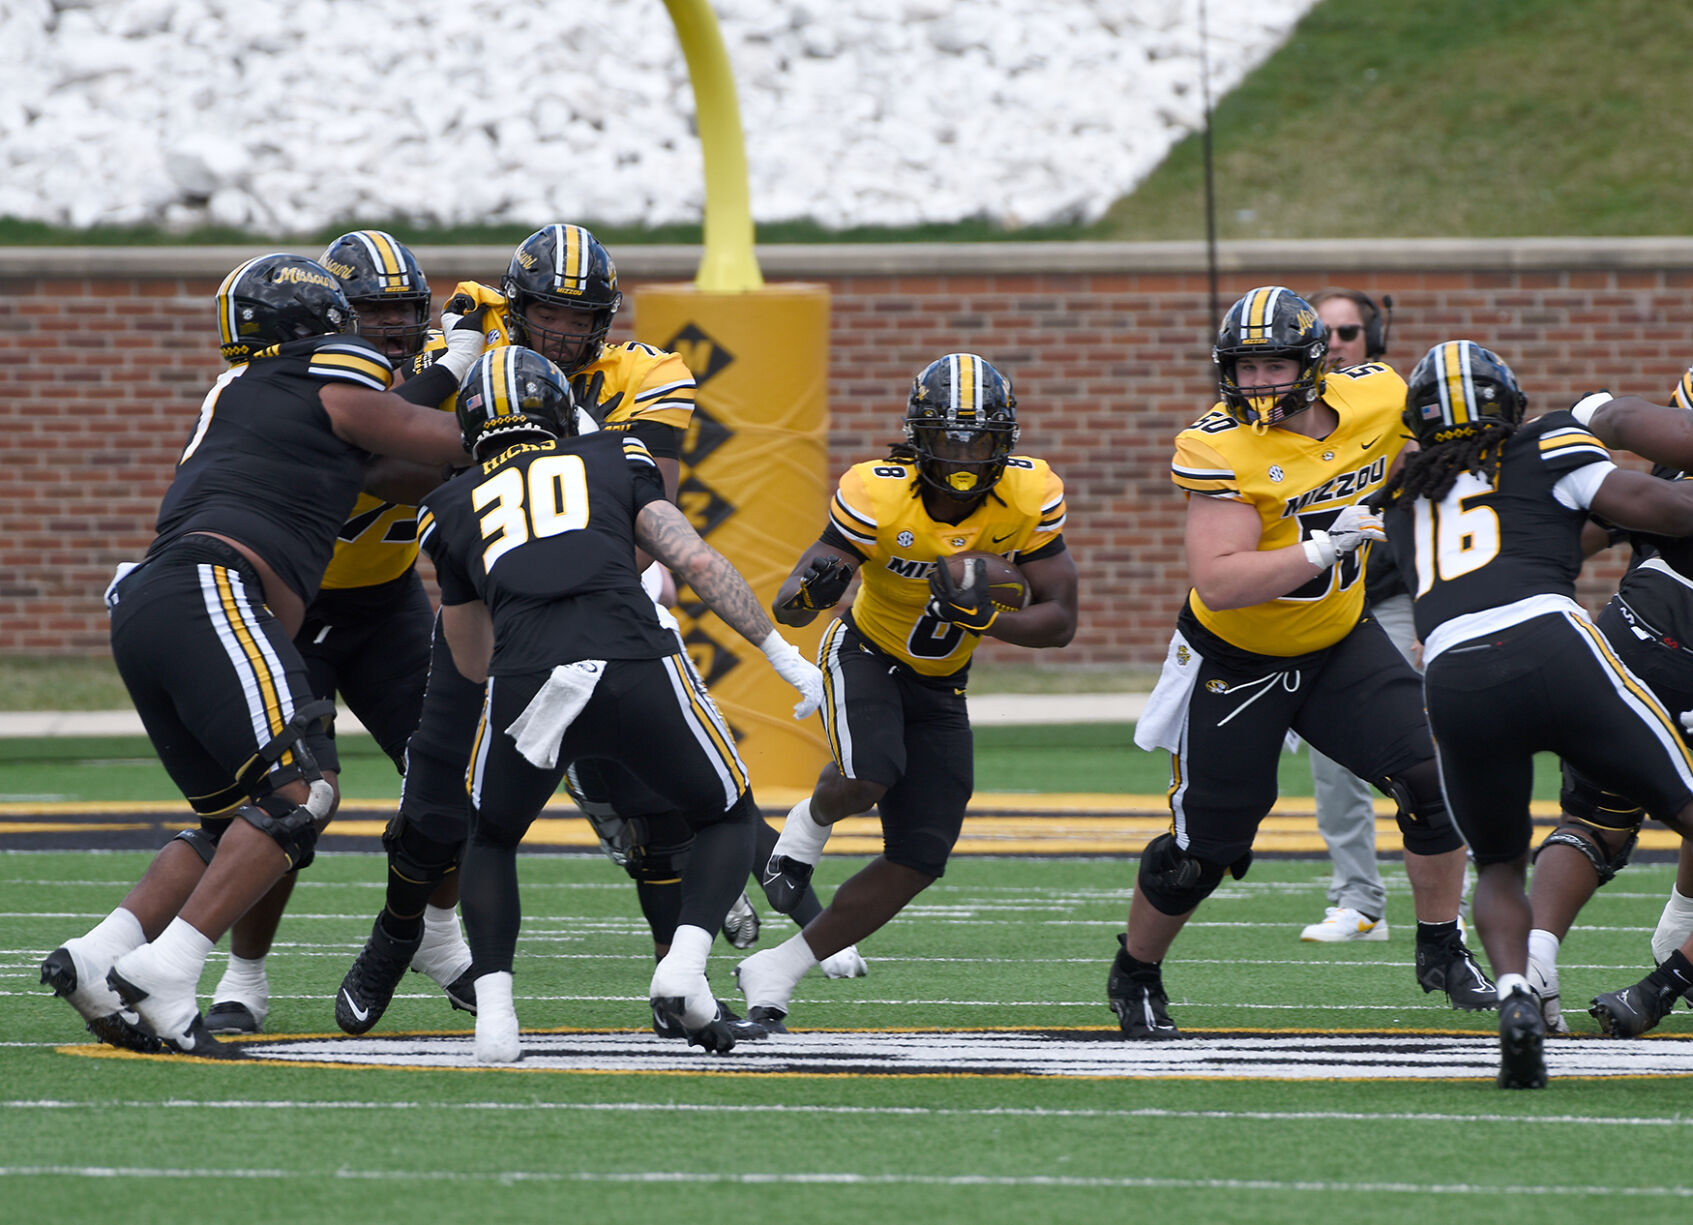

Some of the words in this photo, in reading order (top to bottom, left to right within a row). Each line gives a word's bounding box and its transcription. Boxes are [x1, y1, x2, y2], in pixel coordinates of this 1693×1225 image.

[471, 453, 590, 576] 30
[872, 465, 908, 480] 8
[1280, 454, 1387, 519] MIZZOU
[1413, 456, 1501, 602] 16
